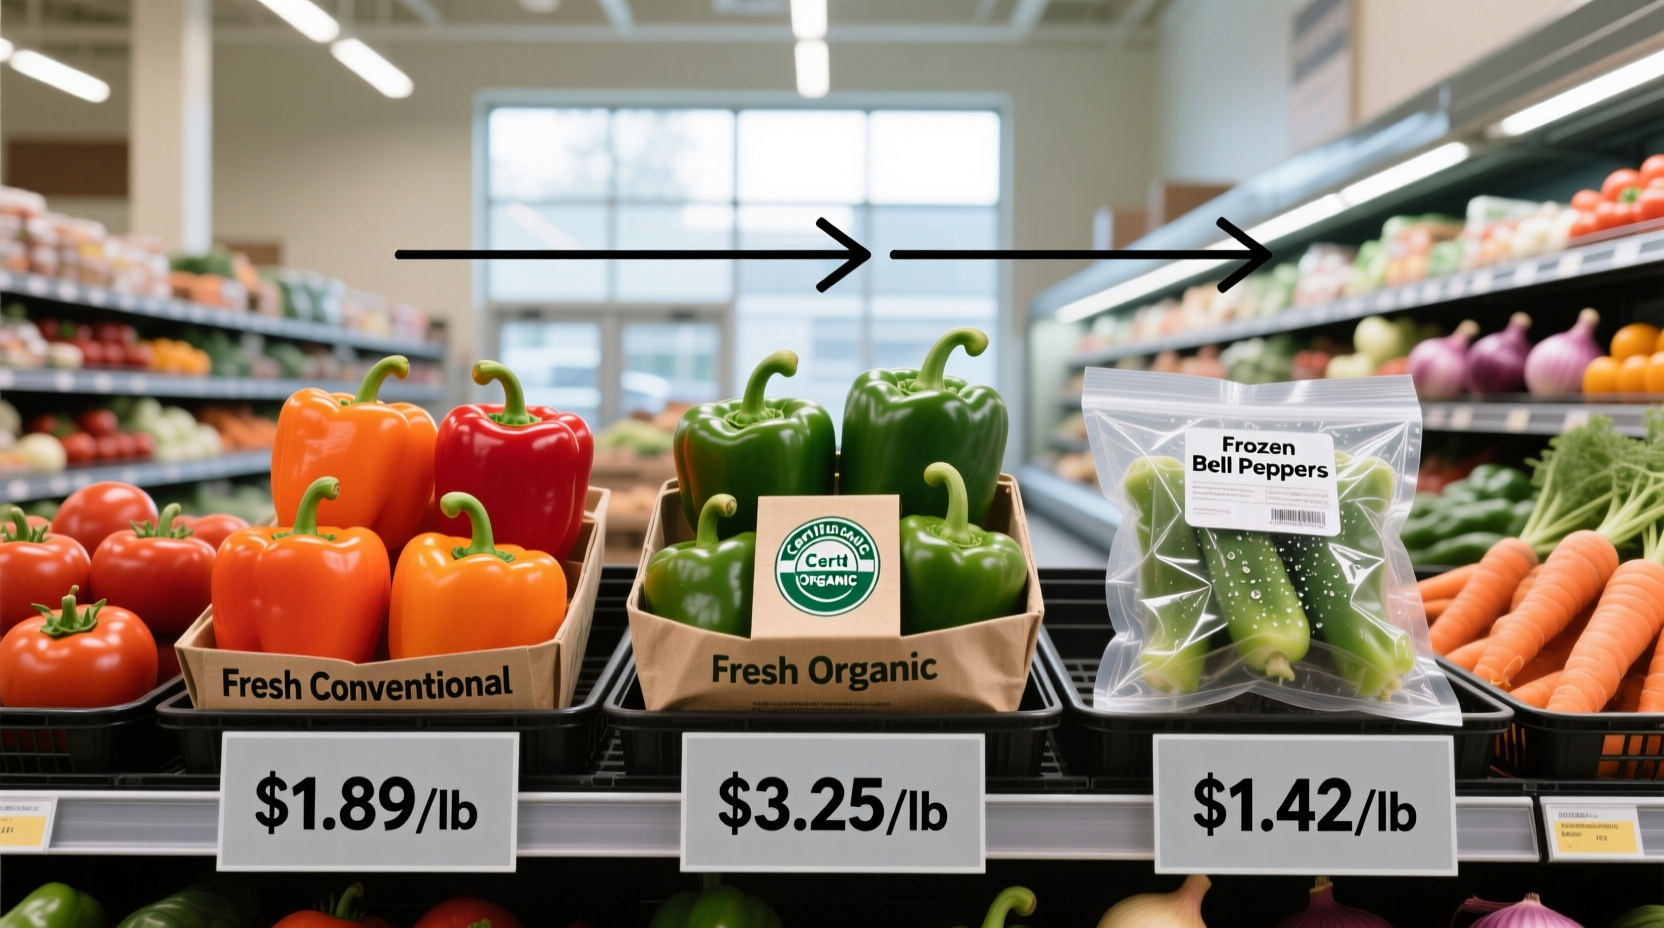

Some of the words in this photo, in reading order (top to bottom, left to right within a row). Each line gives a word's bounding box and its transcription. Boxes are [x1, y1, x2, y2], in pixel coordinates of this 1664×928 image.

[1222, 436, 1296, 455] Frozen
[1192, 455, 1232, 474] Bell
[1238, 457, 1329, 481] Peppers
[222, 667, 303, 700] Fresh
[309, 665, 514, 701] Conventional
[711, 654, 799, 685] Fresh
[808, 652, 938, 691] Organic
[255, 770, 478, 835] $1.89/lb
[718, 771, 948, 836] $3.25/lb
[1193, 772, 1417, 837] $1.42/lb
